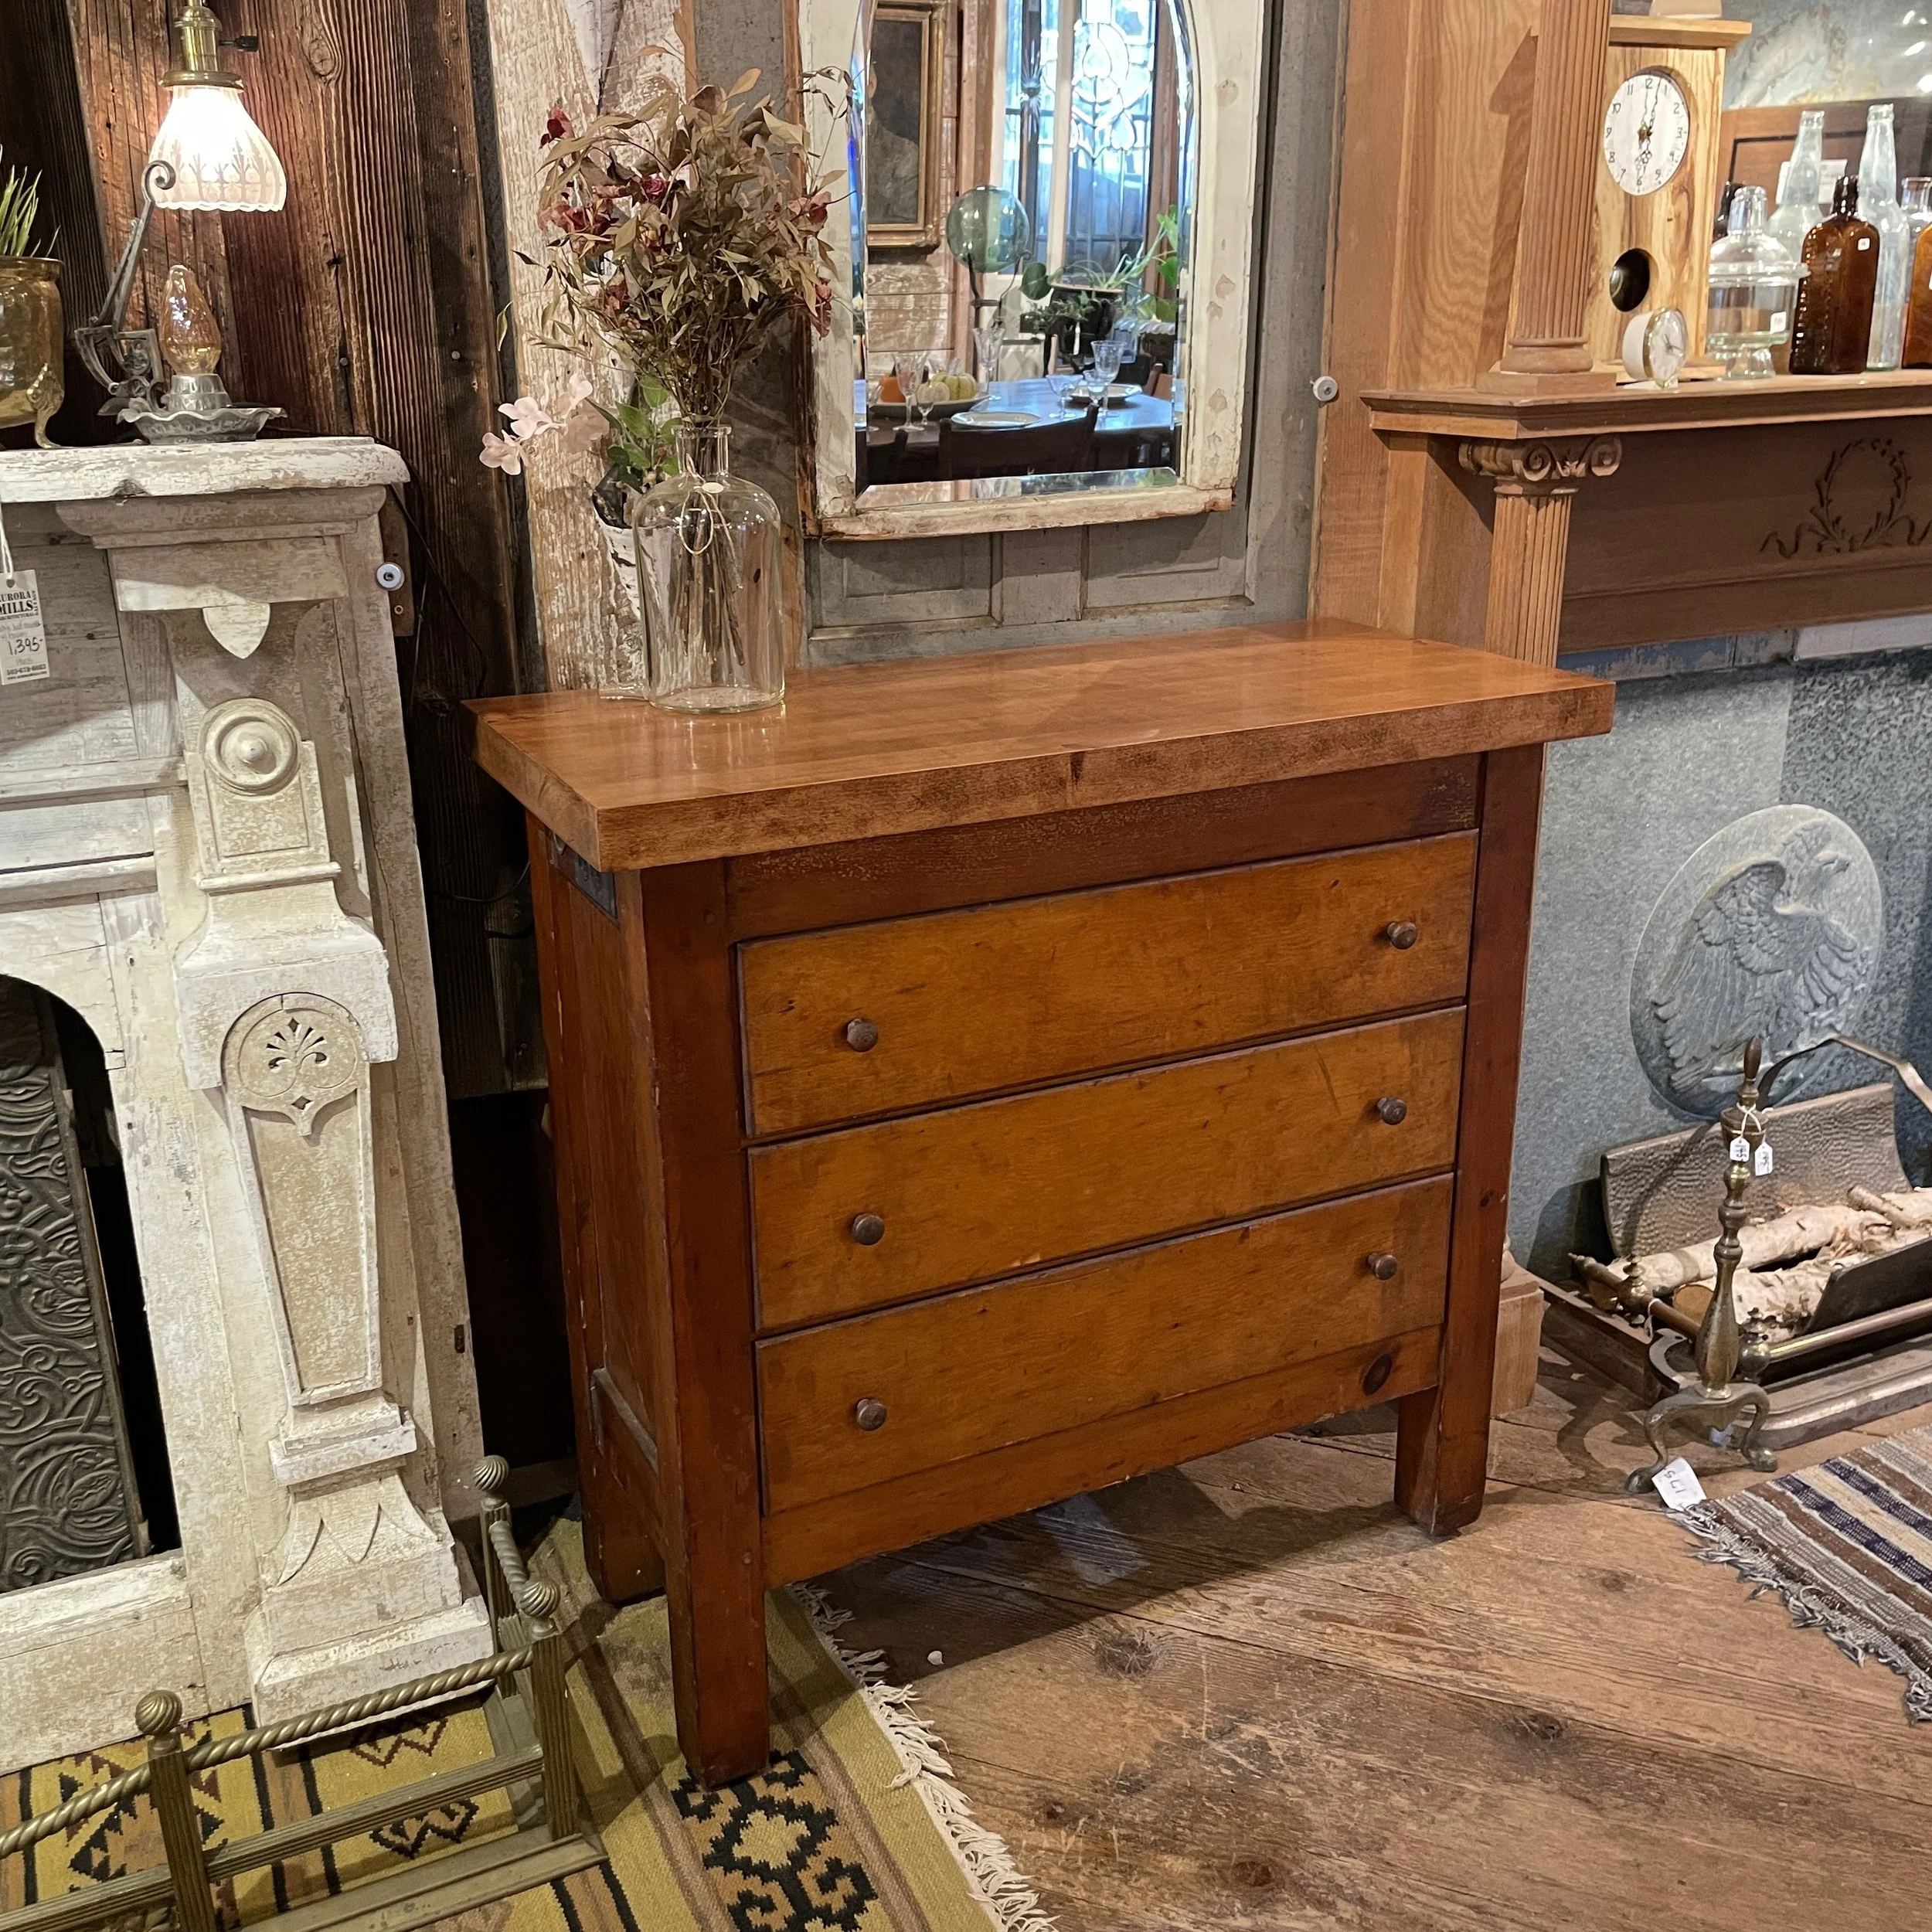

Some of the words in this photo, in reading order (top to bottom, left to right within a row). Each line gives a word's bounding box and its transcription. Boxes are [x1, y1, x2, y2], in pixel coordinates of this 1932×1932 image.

[1645, 77, 1653, 90] 12
[1664, 83, 1668, 96] 1
[1627, 84, 1634, 96] 11
[1673, 102, 1681, 114] 2
[1675, 128, 1683, 139] 3
[1608, 151, 1616, 164] 8
[0, 590, 31, 602] URORA
[1664, 1470, 1686, 1494] 175
